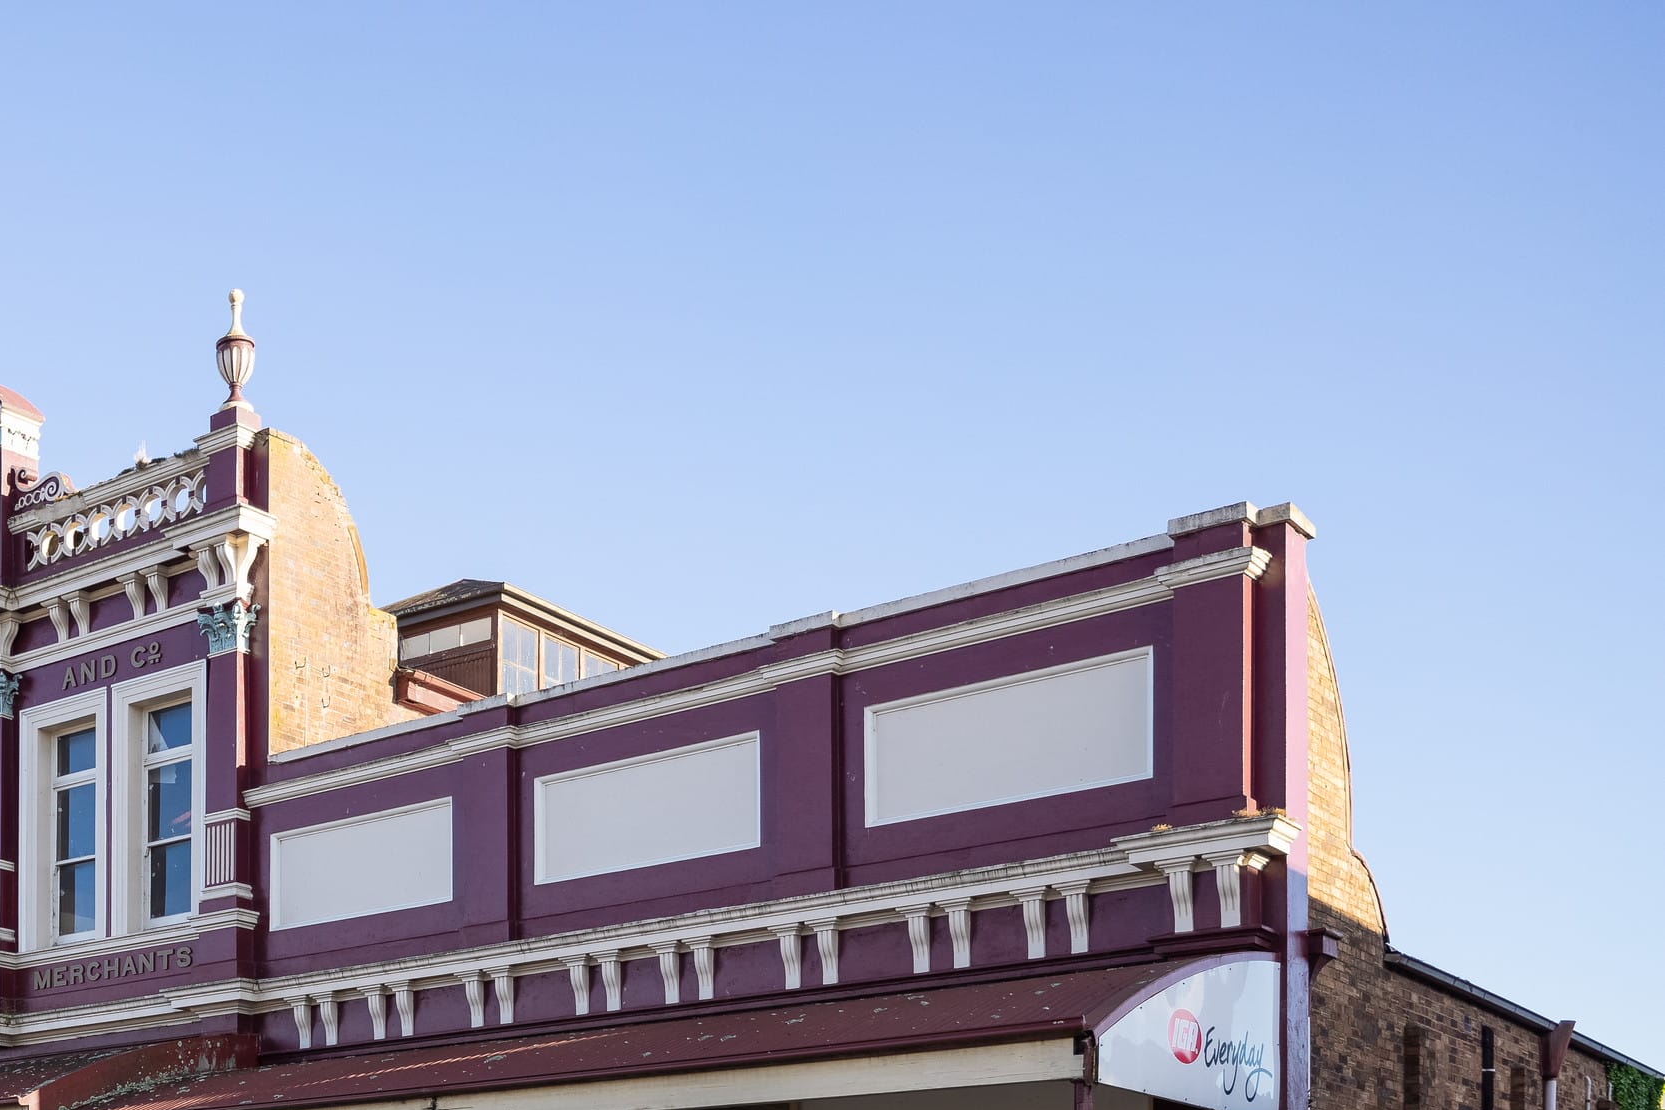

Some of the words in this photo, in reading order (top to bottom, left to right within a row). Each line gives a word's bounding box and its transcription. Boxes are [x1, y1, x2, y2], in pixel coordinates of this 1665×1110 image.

[62, 655, 117, 690] AND
[34, 946, 193, 990] MERCHANTS
[1172, 1018, 1199, 1052] IGA
[1203, 1026, 1273, 1102] Everyday
